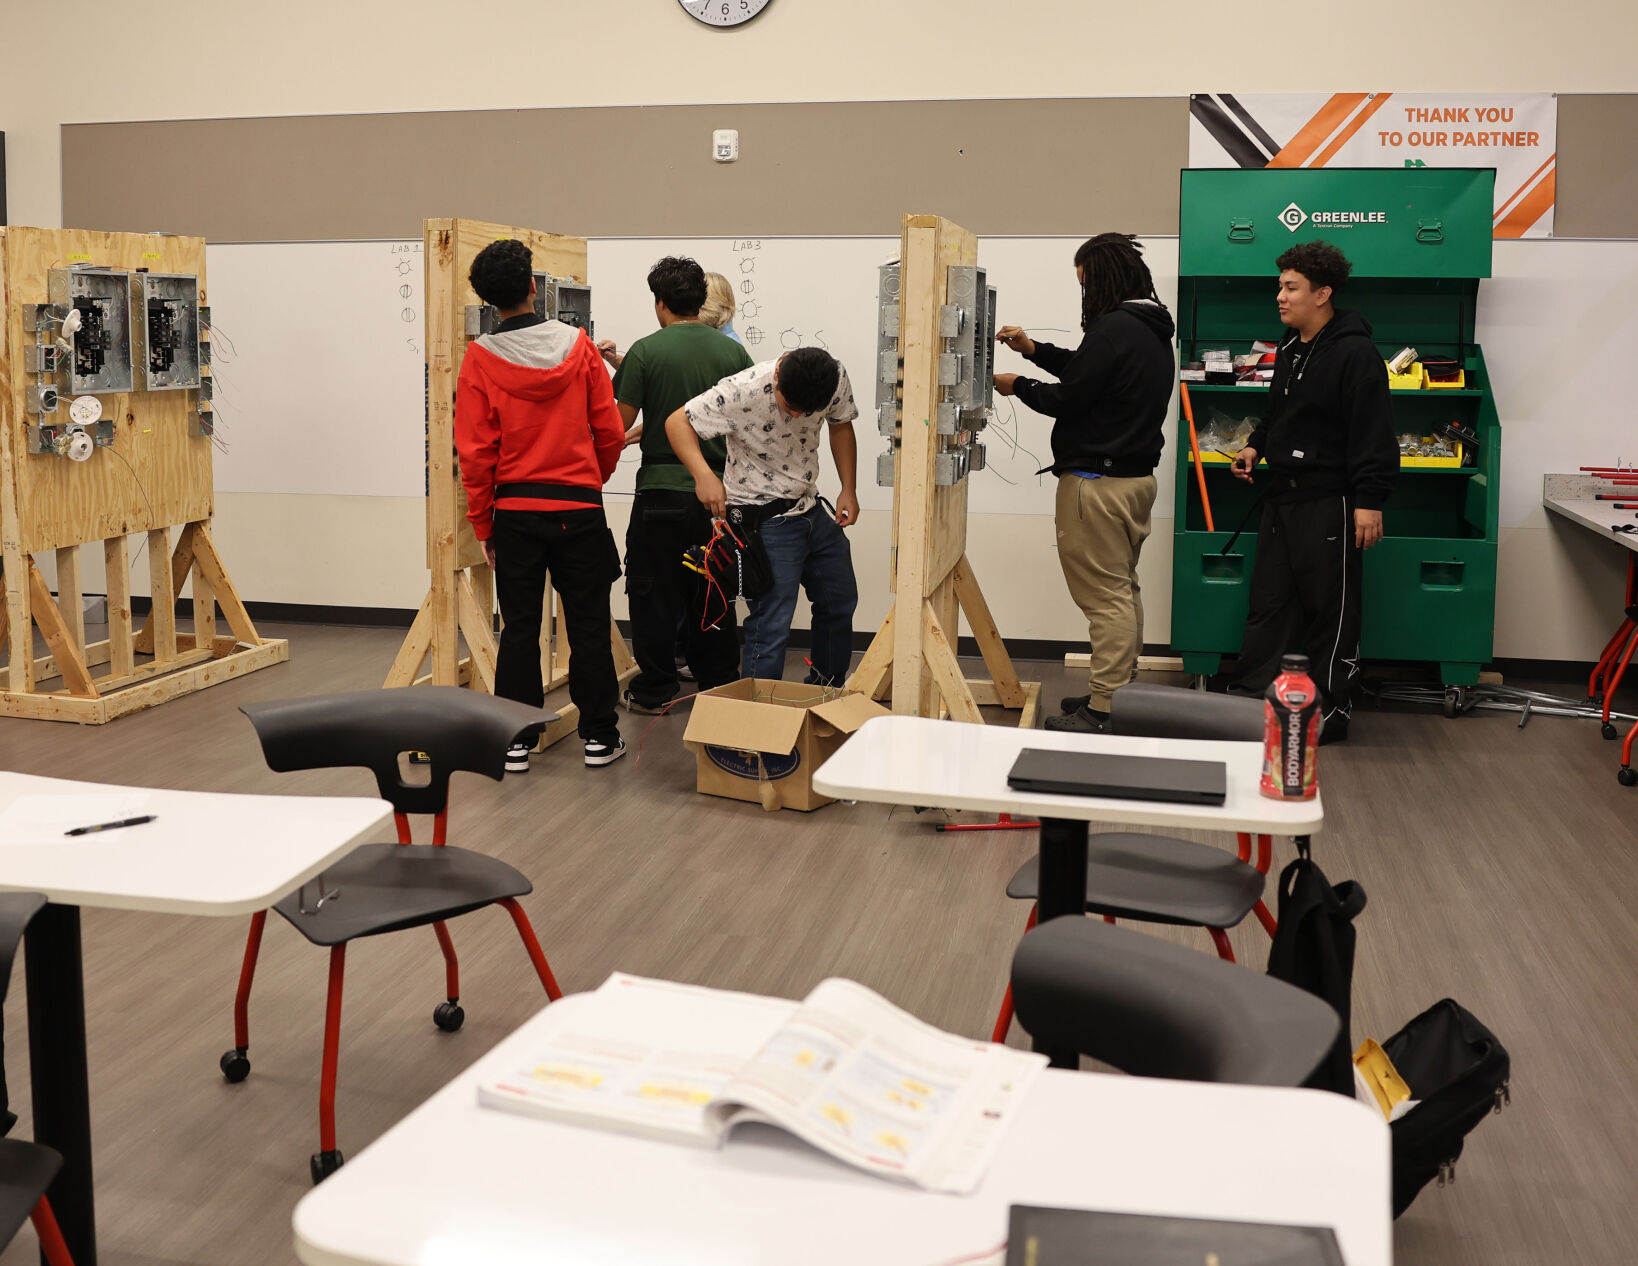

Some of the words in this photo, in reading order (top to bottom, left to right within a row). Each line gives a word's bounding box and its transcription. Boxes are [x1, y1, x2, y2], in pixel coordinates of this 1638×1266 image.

[721, 3, 730, 15] 6
[1405, 107, 1470, 123] THANK
[1475, 107, 1514, 123] YOU
[1378, 131, 1403, 147] TO
[1407, 131, 1448, 147] OUR
[1452, 131, 1540, 147] PARTNER
[1311, 211, 1386, 223] GREENLEE
[391, 244, 410, 254] LAB
[733, 239, 753, 251] LAB
[1287, 712, 1302, 787] BODYARMOR
